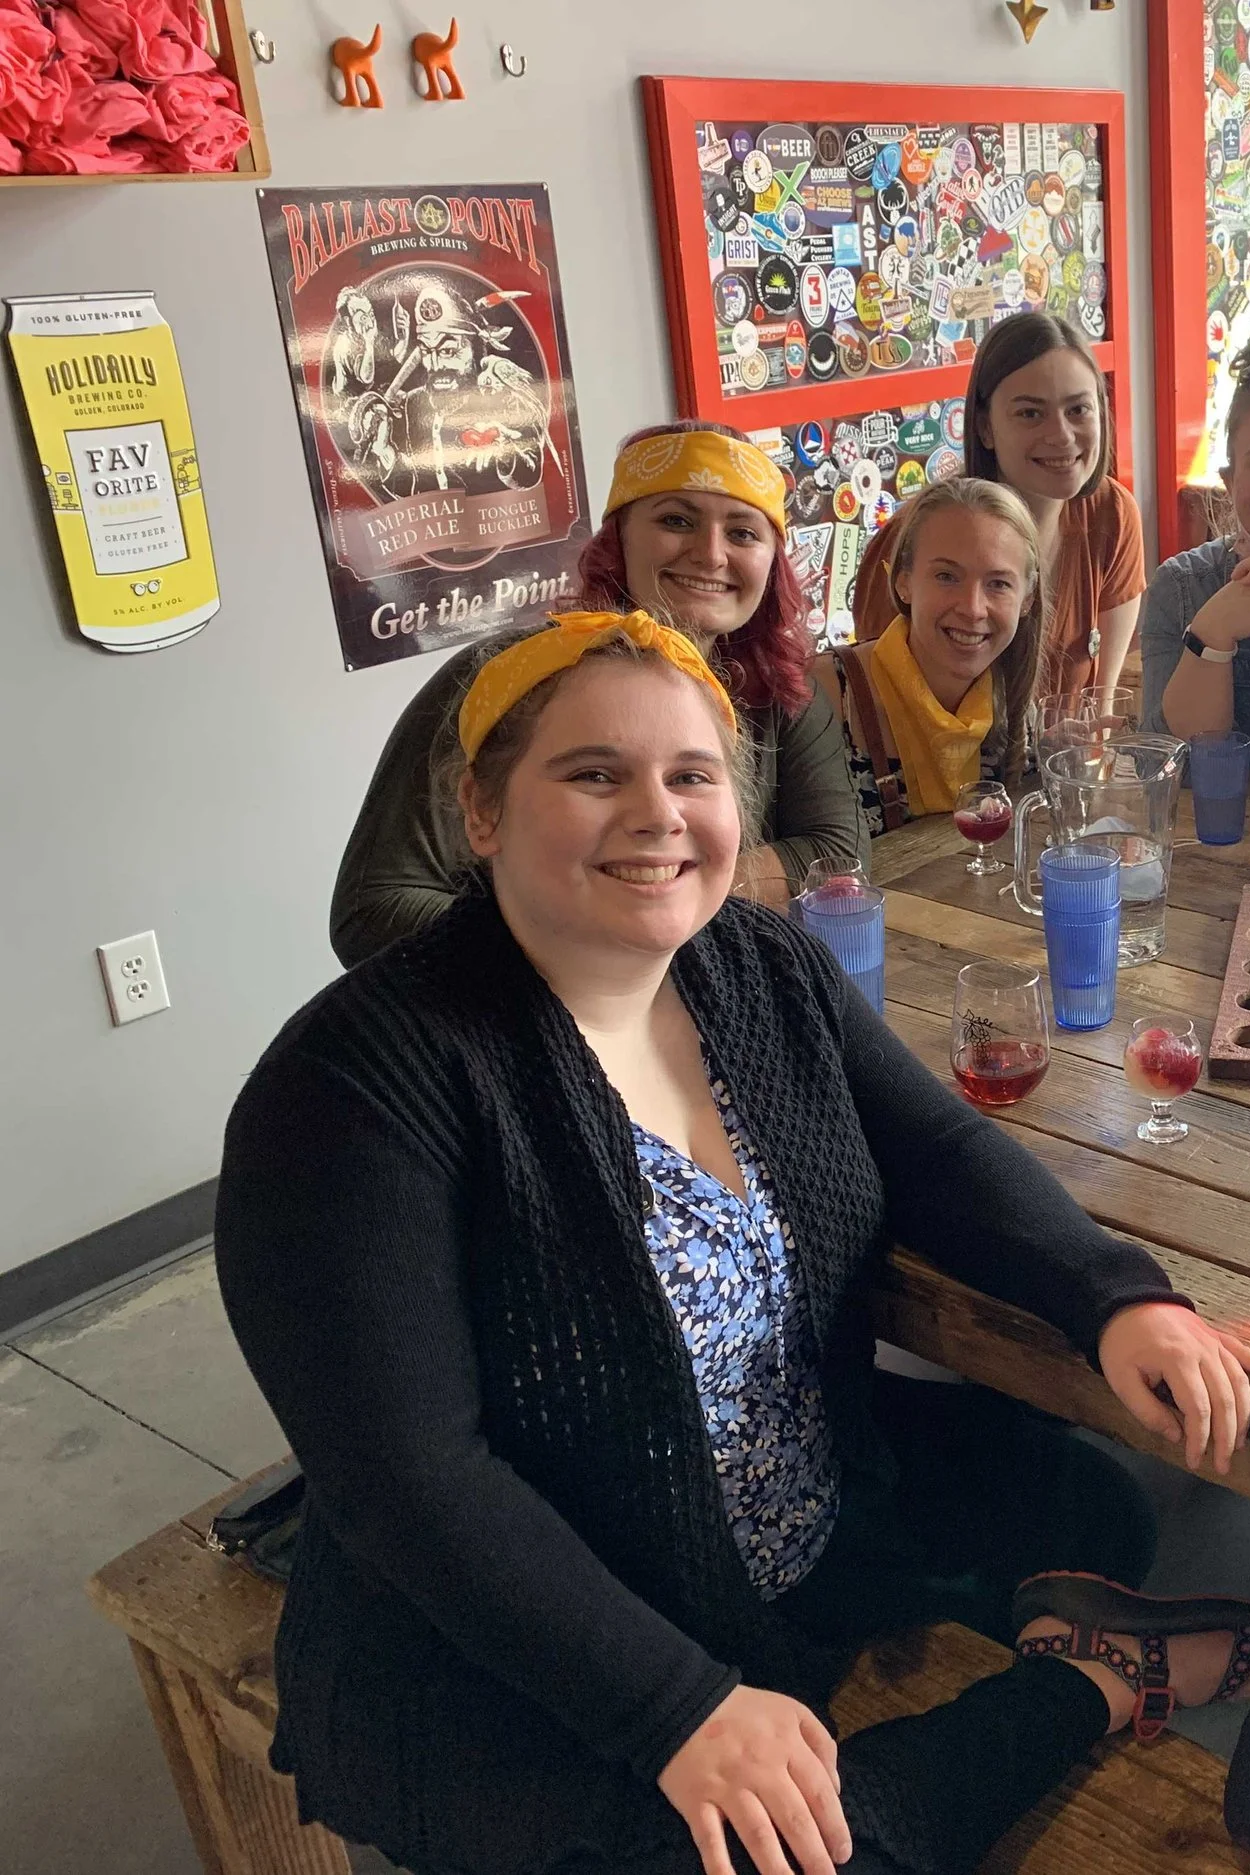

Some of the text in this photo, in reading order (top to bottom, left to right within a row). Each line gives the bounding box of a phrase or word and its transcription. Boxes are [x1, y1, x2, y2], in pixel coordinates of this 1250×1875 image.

[781, 139, 811, 157] BEER
[846, 143, 877, 167] CREEK
[816, 186, 852, 199] CHOOSE
[718, 204, 737, 227] INSIGHT
[281, 196, 541, 294] BALLAST POINT
[371, 236, 469, 256] BREWING & SPIRITS
[727, 239, 757, 259] GRIST
[807, 276, 822, 305] 3
[31, 310, 143, 324] 100% GLUTEN-FREE
[45, 354, 157, 396] HOLIDAILY
[68, 388, 148, 405] BREWING CO.
[74, 402, 145, 416] GOLDEN, COLORADO
[86, 443, 150, 473] FAV
[876, 456, 895, 466] PEAK
[94, 474, 158, 497] ORITE
[367, 498, 465, 538] IMPERIAL
[478, 499, 538, 521] TONGUE
[105, 526, 166, 543] CRAFT BEER
[478, 512, 541, 535] BUCKLER
[378, 518, 460, 556] RED ALE
[108, 541, 169, 557] GLUTEN FREE
[840, 527, 852, 575] HOPS
[151, 602, 162, 610] BY
[370, 601, 430, 640] Get
[436, 586, 484, 626] the
